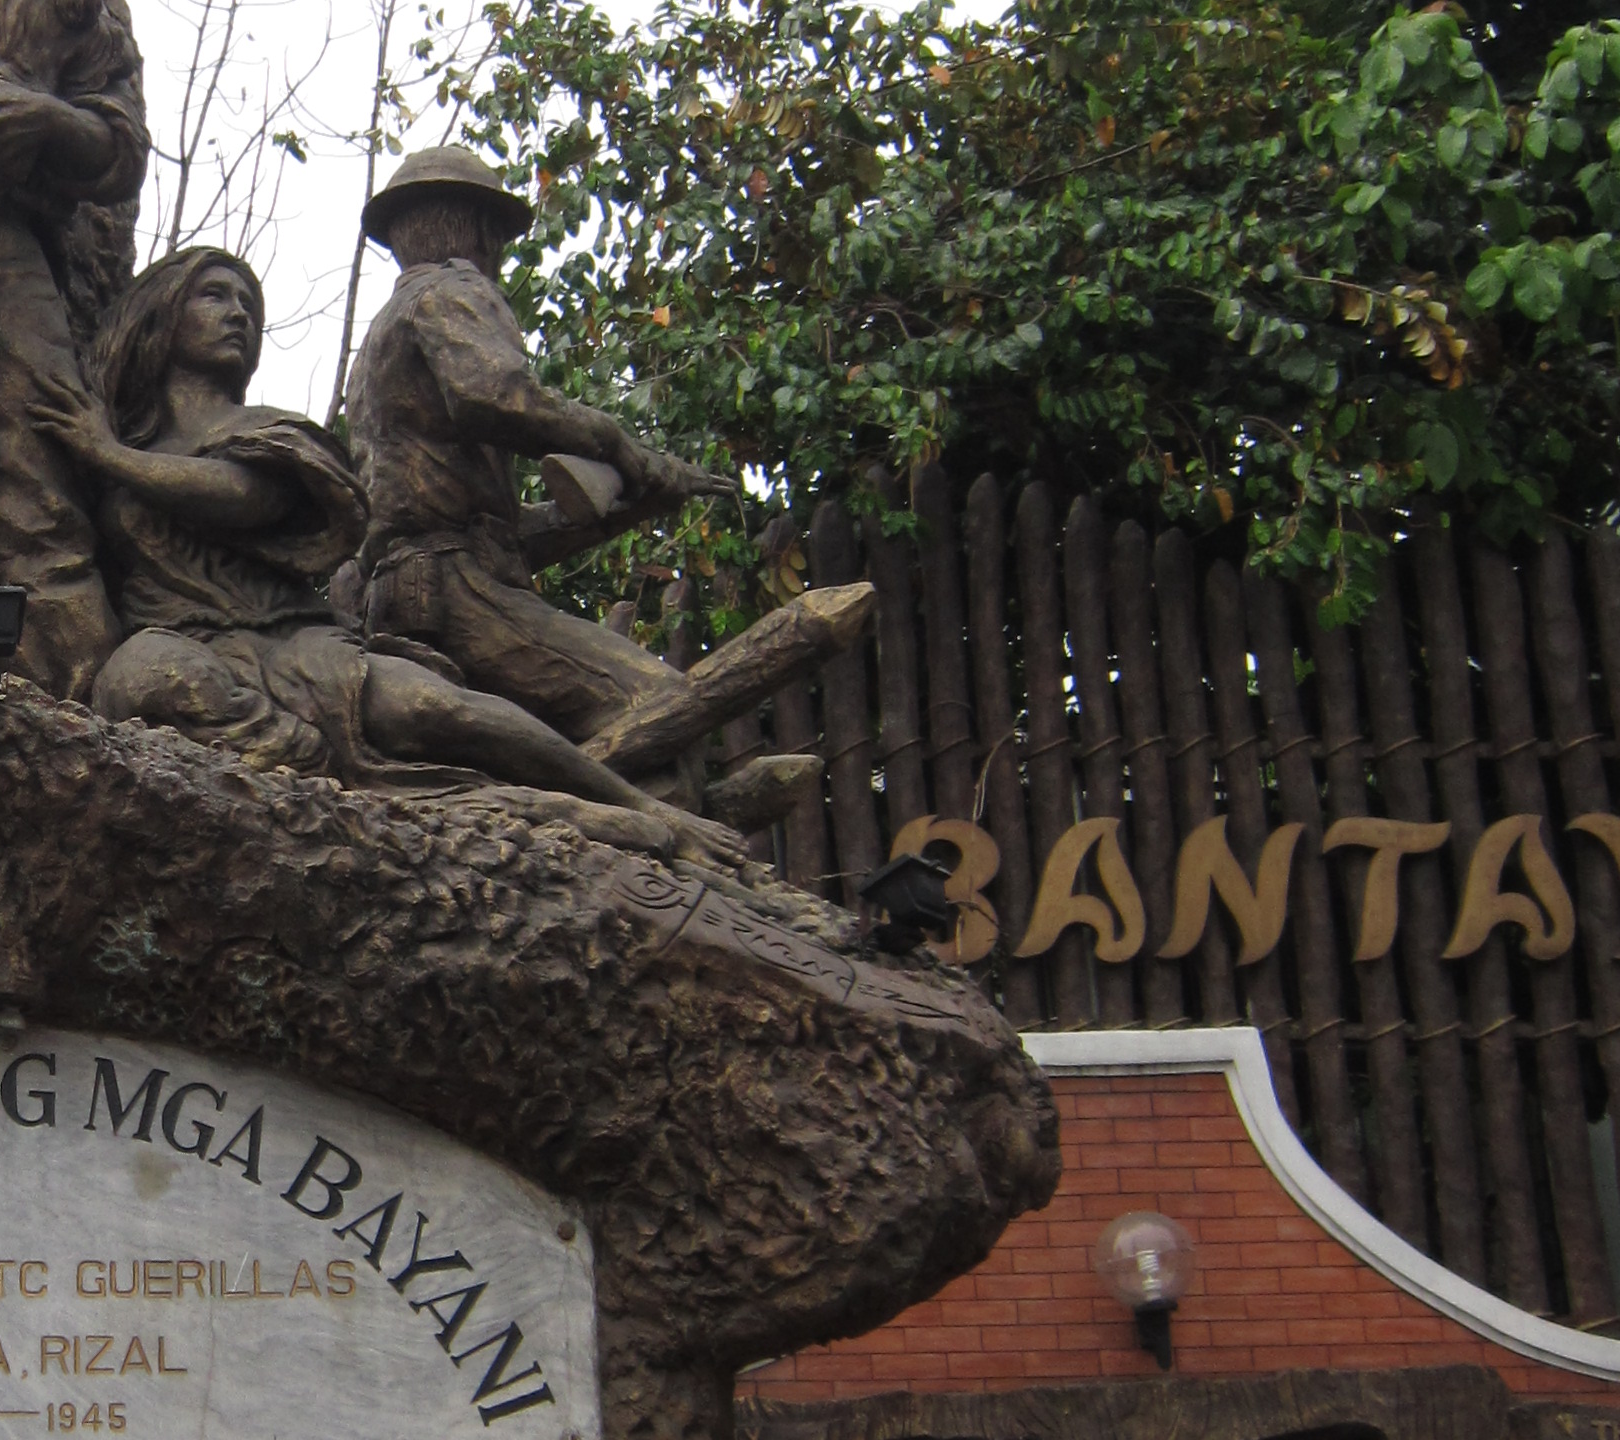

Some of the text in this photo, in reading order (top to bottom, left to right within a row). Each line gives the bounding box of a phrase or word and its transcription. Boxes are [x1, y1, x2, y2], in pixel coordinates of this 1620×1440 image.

[83, 1056, 265, 1185] MGA
[279, 1134, 555, 1427] BAYANI
[75, 1257, 357, 1299] GUERILLAS
[39, 1335, 188, 1376] RIZAL
